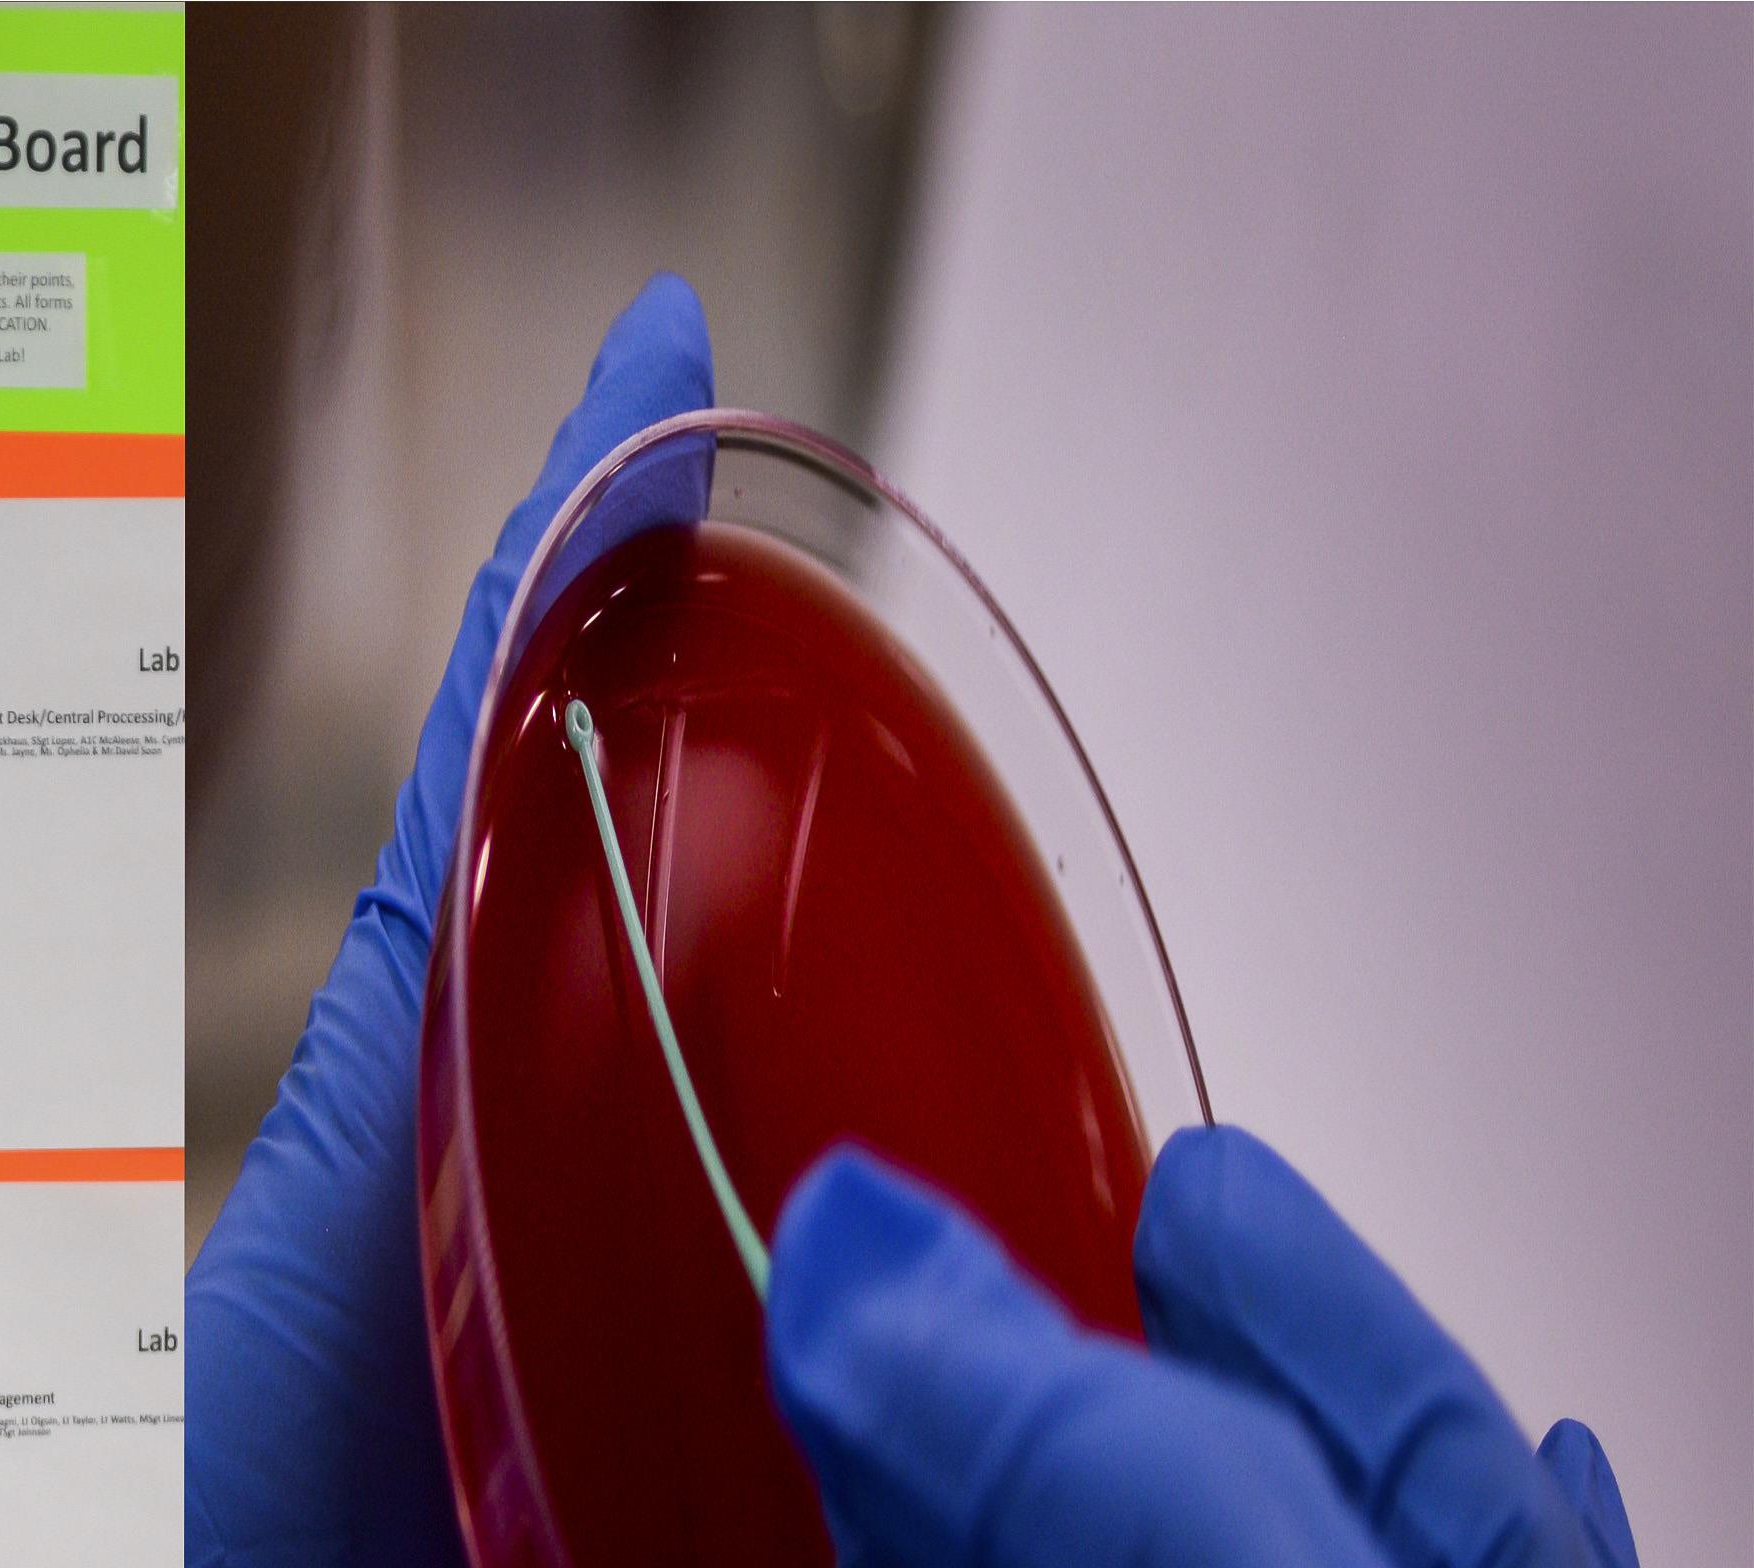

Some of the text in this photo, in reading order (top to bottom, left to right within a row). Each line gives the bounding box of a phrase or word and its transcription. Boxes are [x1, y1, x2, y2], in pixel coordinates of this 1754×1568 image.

[31, 273, 76, 291] points,
[15, 295, 33, 309] All
[36, 295, 74, 310] forms
[139, 646, 180, 672] Lab
[6, 708, 94, 727] Desk/Central
[31, 735, 50, 748] SSgt
[138, 1327, 178, 1353] Lab
[139, 1415, 161, 1428] MSgt
